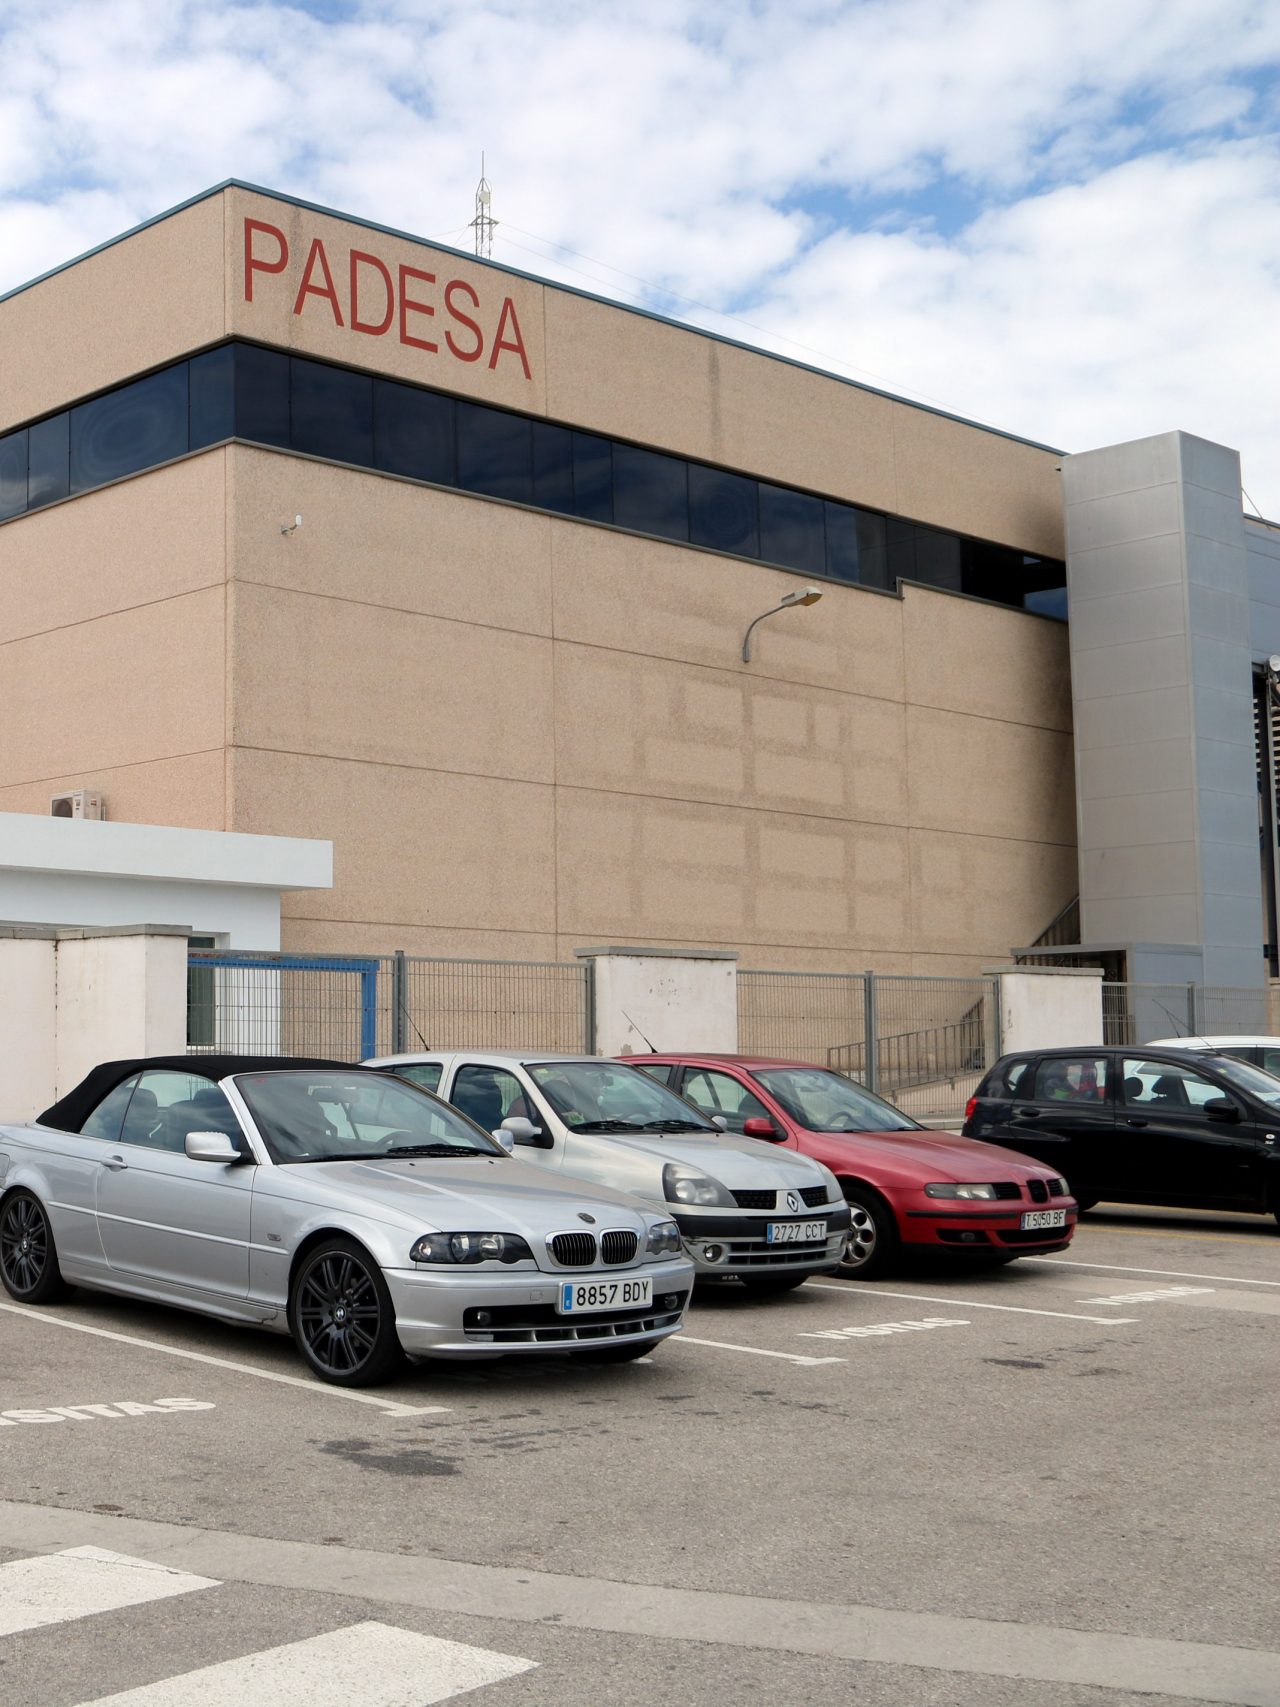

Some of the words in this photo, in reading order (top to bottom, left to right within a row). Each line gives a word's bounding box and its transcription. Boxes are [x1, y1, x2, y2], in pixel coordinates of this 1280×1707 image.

[244, 217, 532, 381] PADESA
[1054, 1212, 1064, 1224] BF
[774, 1224, 801, 1241] 2727
[805, 1223, 824, 1239] CCT
[577, 1285, 618, 1306] 8857
[623, 1281, 649, 1303] BDY
[1074, 1286, 1217, 1306] VISITAS
[796, 1317, 972, 1340] VISITAS
